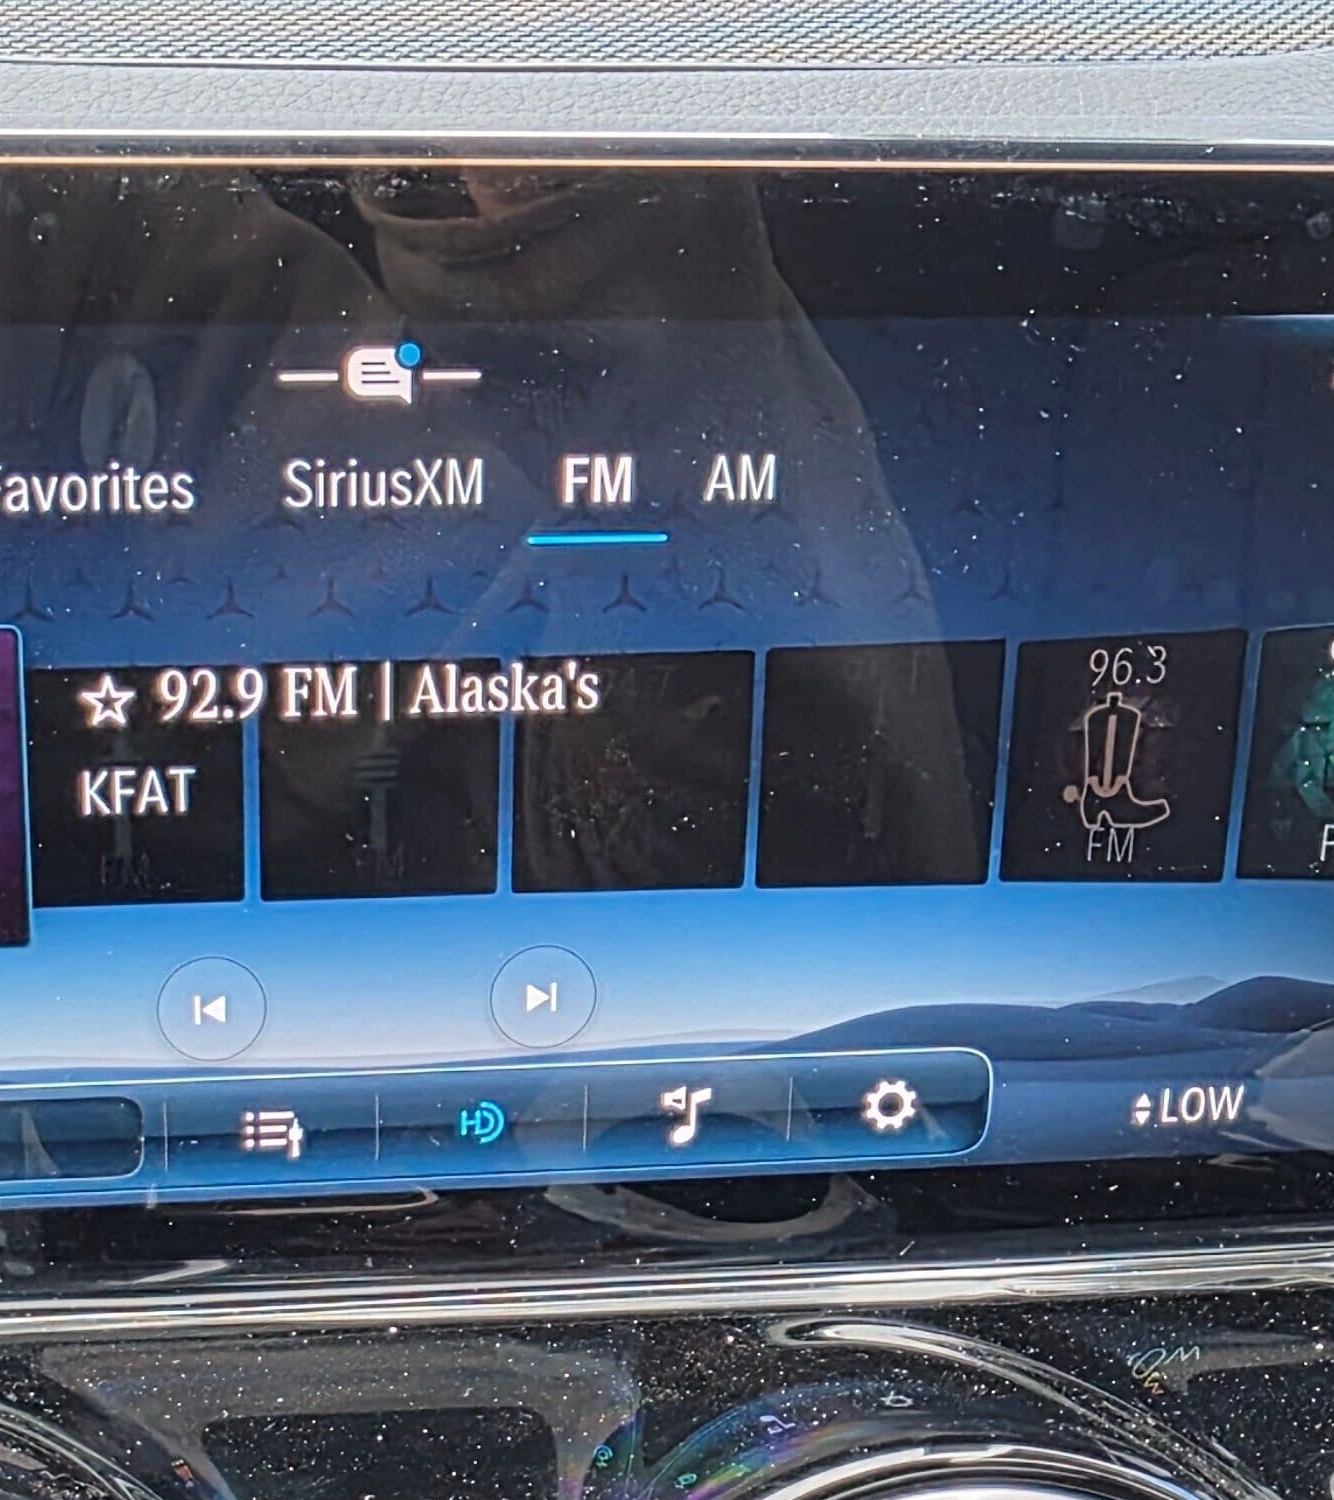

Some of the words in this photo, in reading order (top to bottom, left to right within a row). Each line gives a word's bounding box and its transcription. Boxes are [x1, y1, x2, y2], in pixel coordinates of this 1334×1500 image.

[283, 457, 485, 510] SiriusXM
[562, 456, 633, 504] FM
[704, 454, 777, 502] AM
[1088, 645, 1168, 687] 96.3
[157, 668, 265, 722] 92.9
[282, 666, 358, 718] FM
[408, 660, 600, 717] Alaska's
[79, 768, 197, 816] KFAT
[1086, 826, 1135, 862] FM
[1161, 1085, 1245, 1124] LOW
